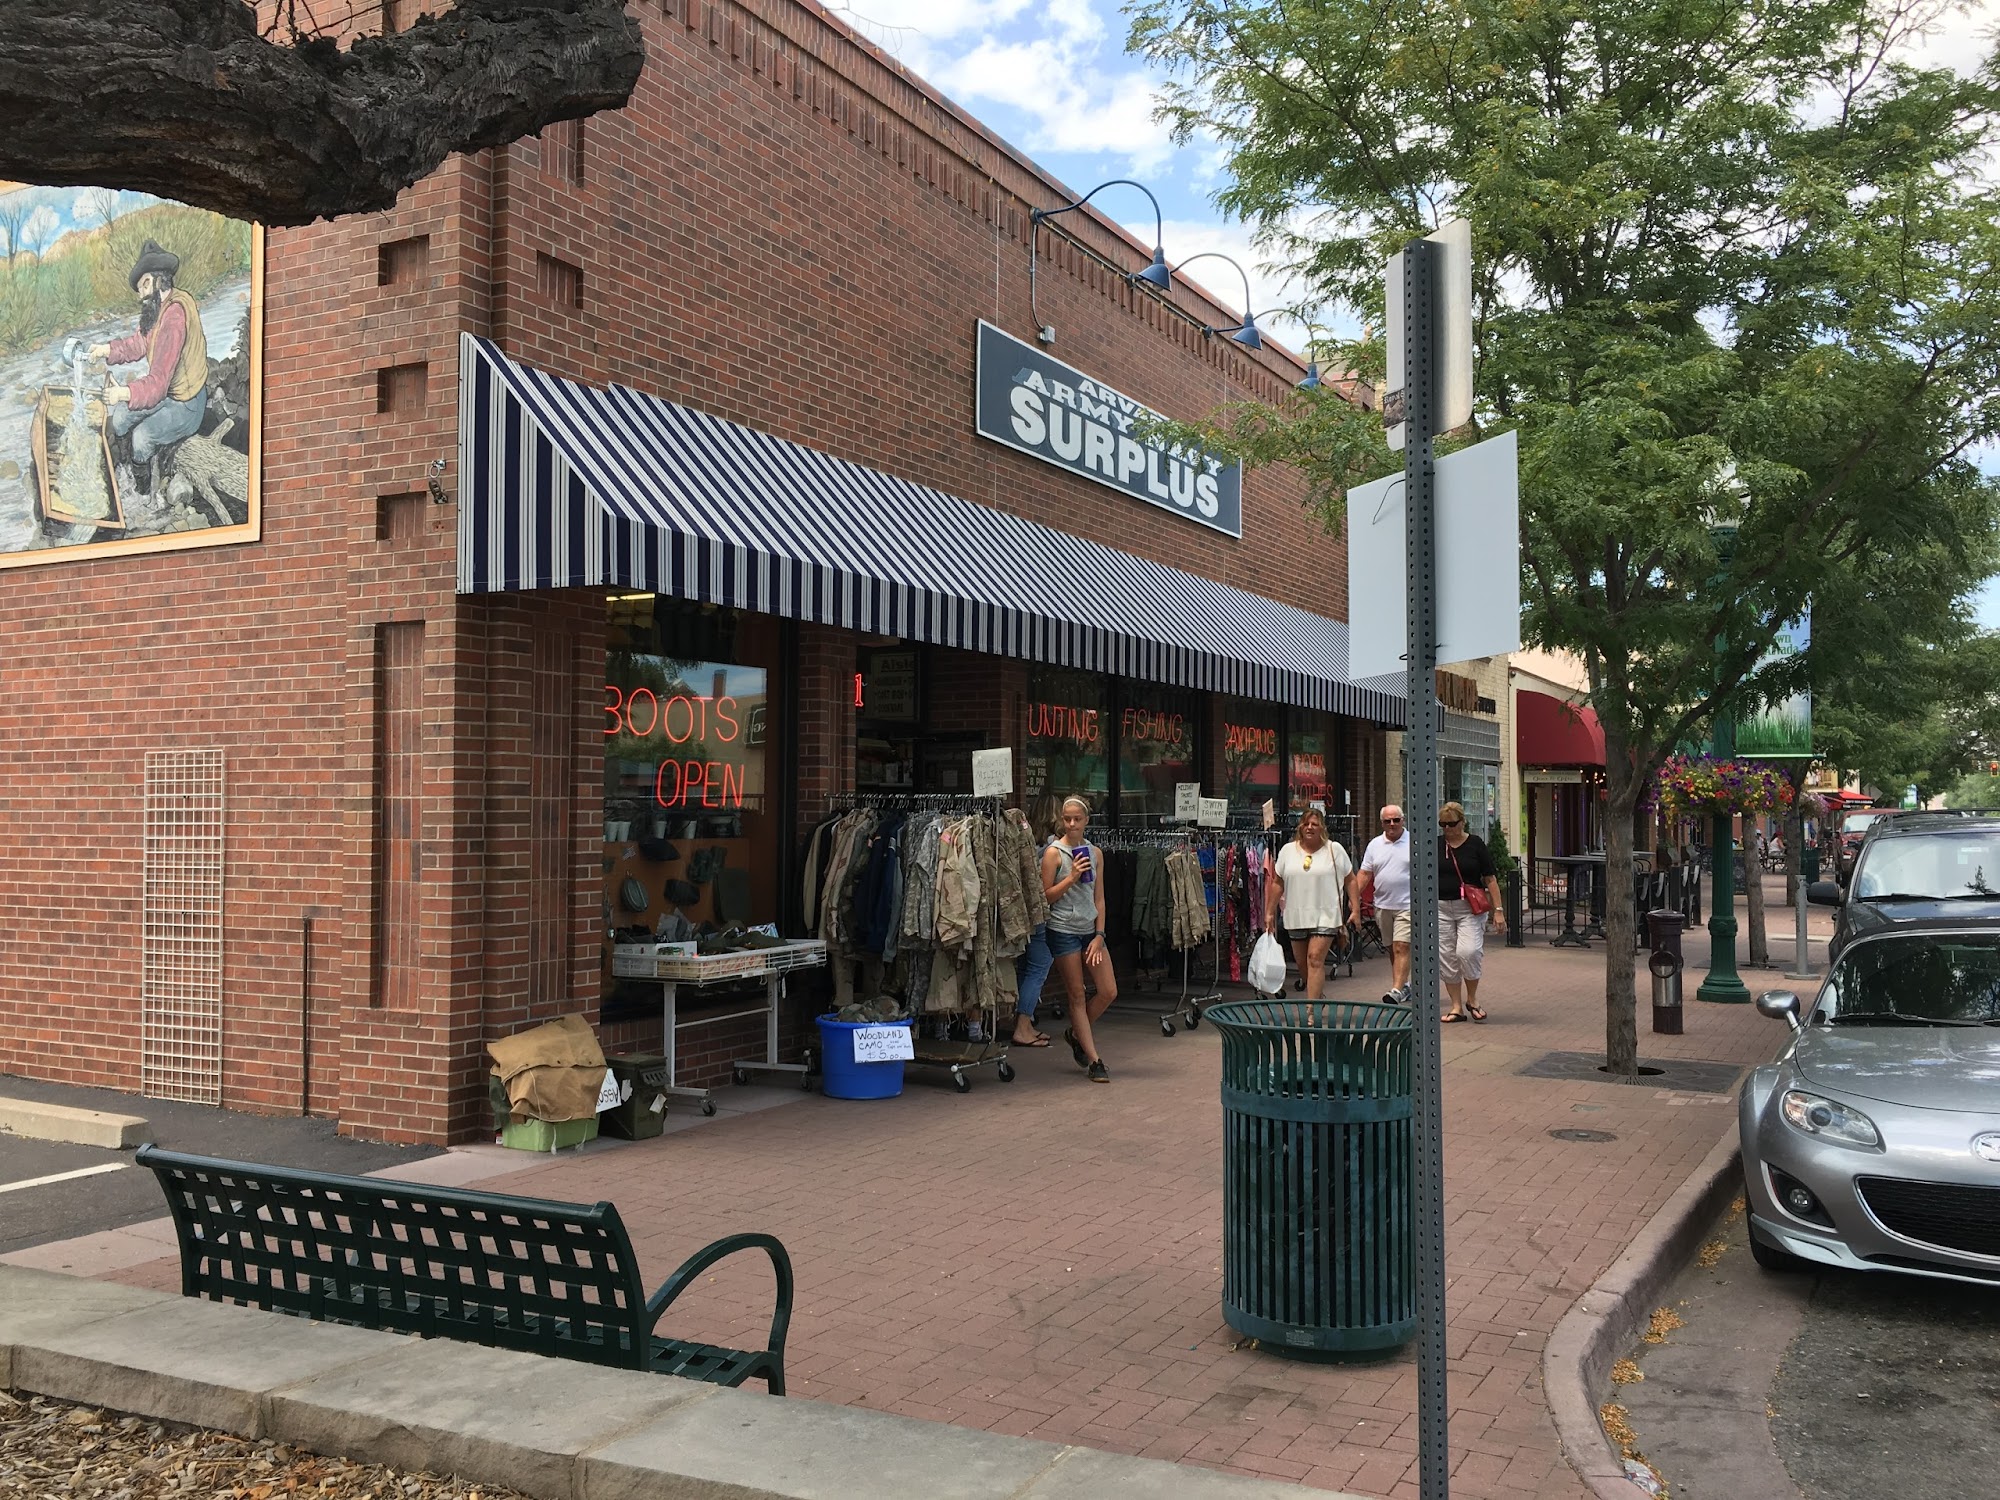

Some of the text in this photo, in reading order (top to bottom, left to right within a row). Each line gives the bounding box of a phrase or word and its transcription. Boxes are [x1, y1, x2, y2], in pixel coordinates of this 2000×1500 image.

[1024, 370, 1134, 434] ARMY
[1010, 385, 1219, 519] SURPLUS
[603, 685, 739, 744] BOOTS
[1122, 708, 1183, 744] FISHING
[655, 758, 745, 809] OPEN
[1028, 757, 1047, 767] HOURS
[855, 1028, 904, 1040] WOODLAND
[858, 1040, 883, 1051] CAMO
